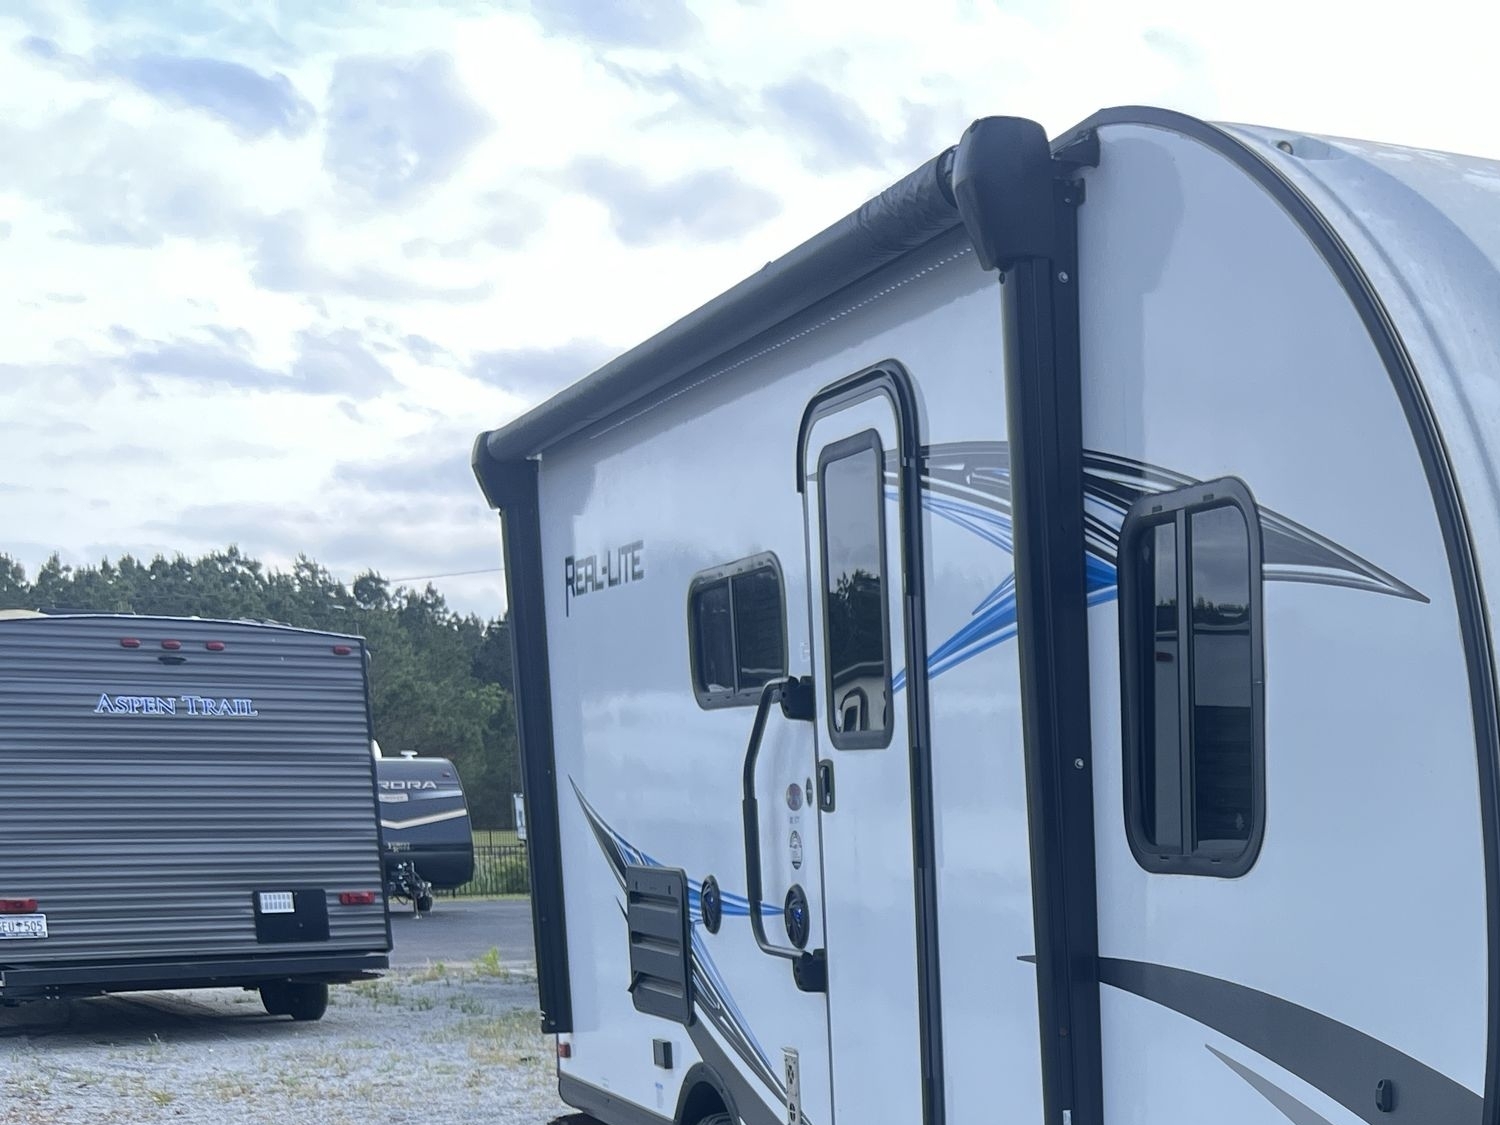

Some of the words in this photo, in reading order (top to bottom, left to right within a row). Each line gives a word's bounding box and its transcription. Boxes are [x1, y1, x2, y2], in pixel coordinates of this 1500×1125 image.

[565, 540, 644, 618] REAL-LITE
[94, 693, 176, 715] ASPEN
[181, 695, 258, 716] TRAIL
